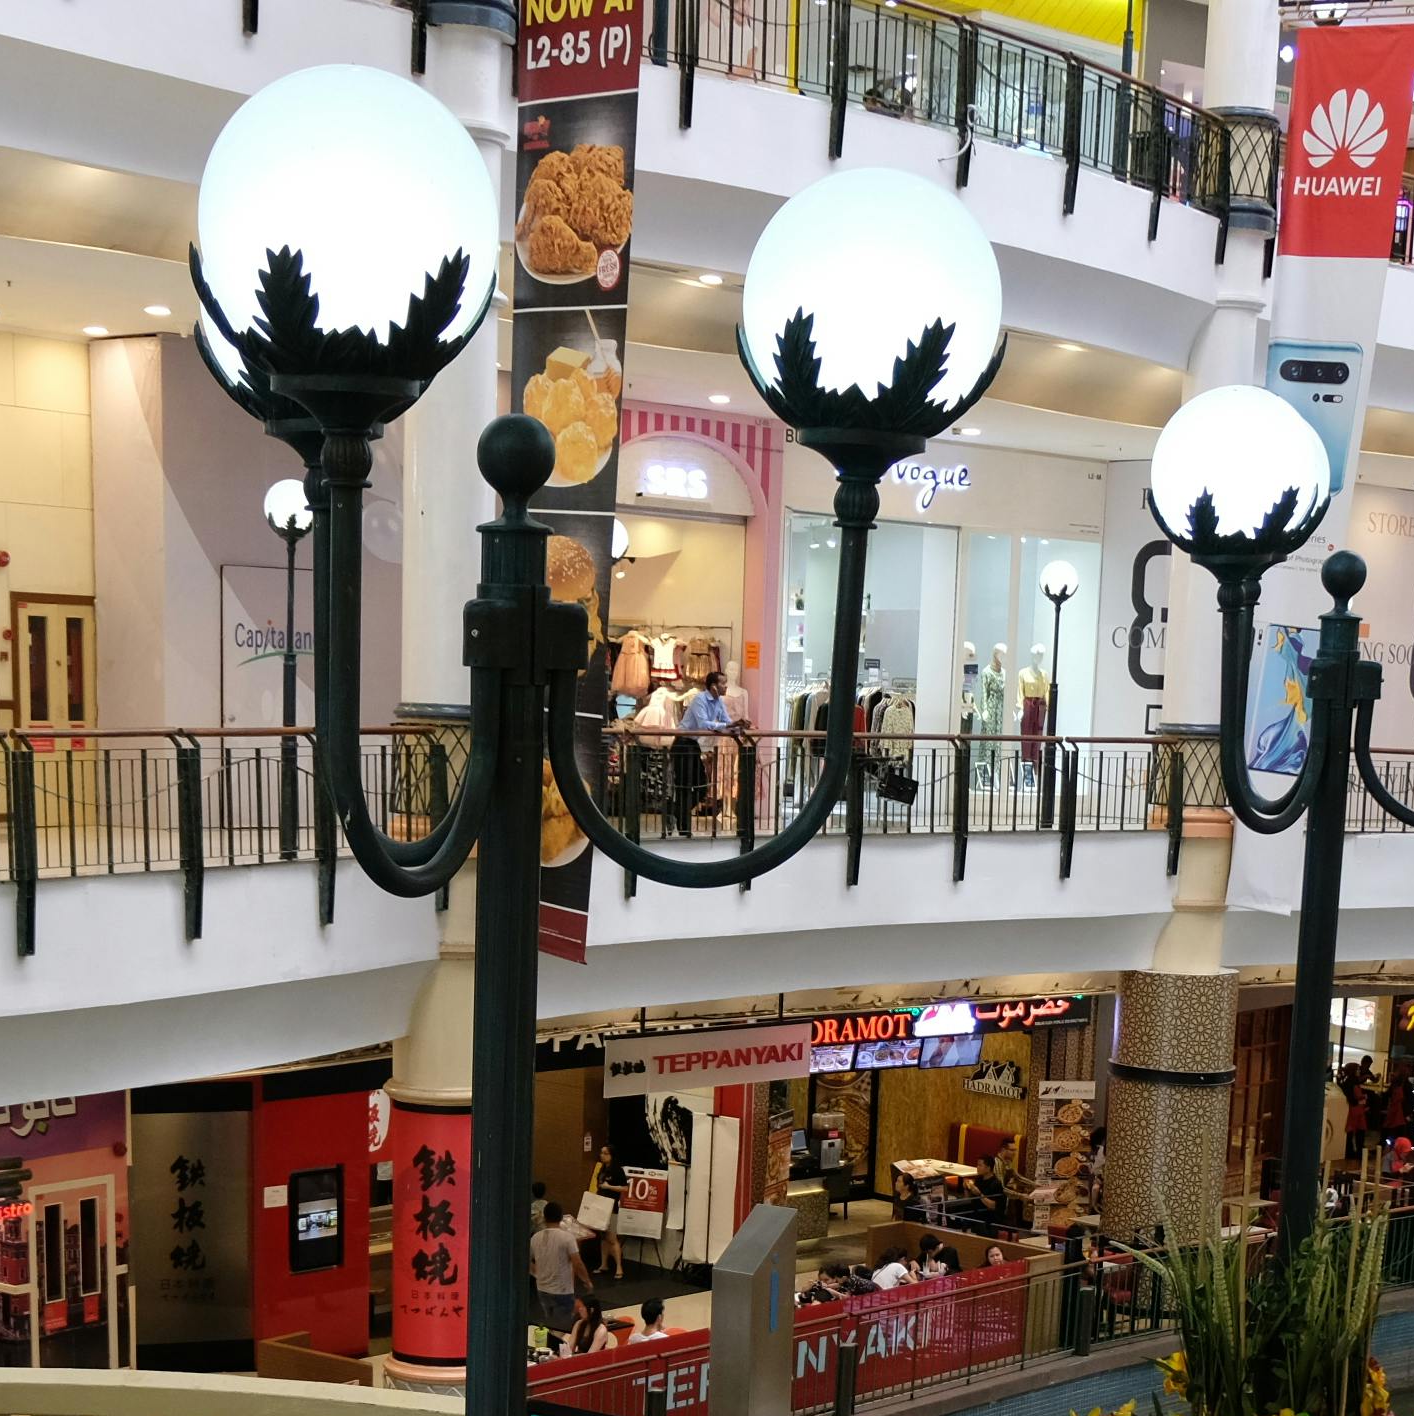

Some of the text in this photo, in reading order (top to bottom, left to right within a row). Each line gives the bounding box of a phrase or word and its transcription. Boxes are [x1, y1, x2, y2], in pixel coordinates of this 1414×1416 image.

[526, 23, 632, 70] L2-85 (P)
[1293, 175, 1382, 198] HUAWEI
[893, 463, 973, 511] vogue
[234, 619, 314, 655] Capitaan
[652, 1042, 805, 1075] TEPPANYAKI
[962, 1077, 1024, 1100] HADRAMOT
